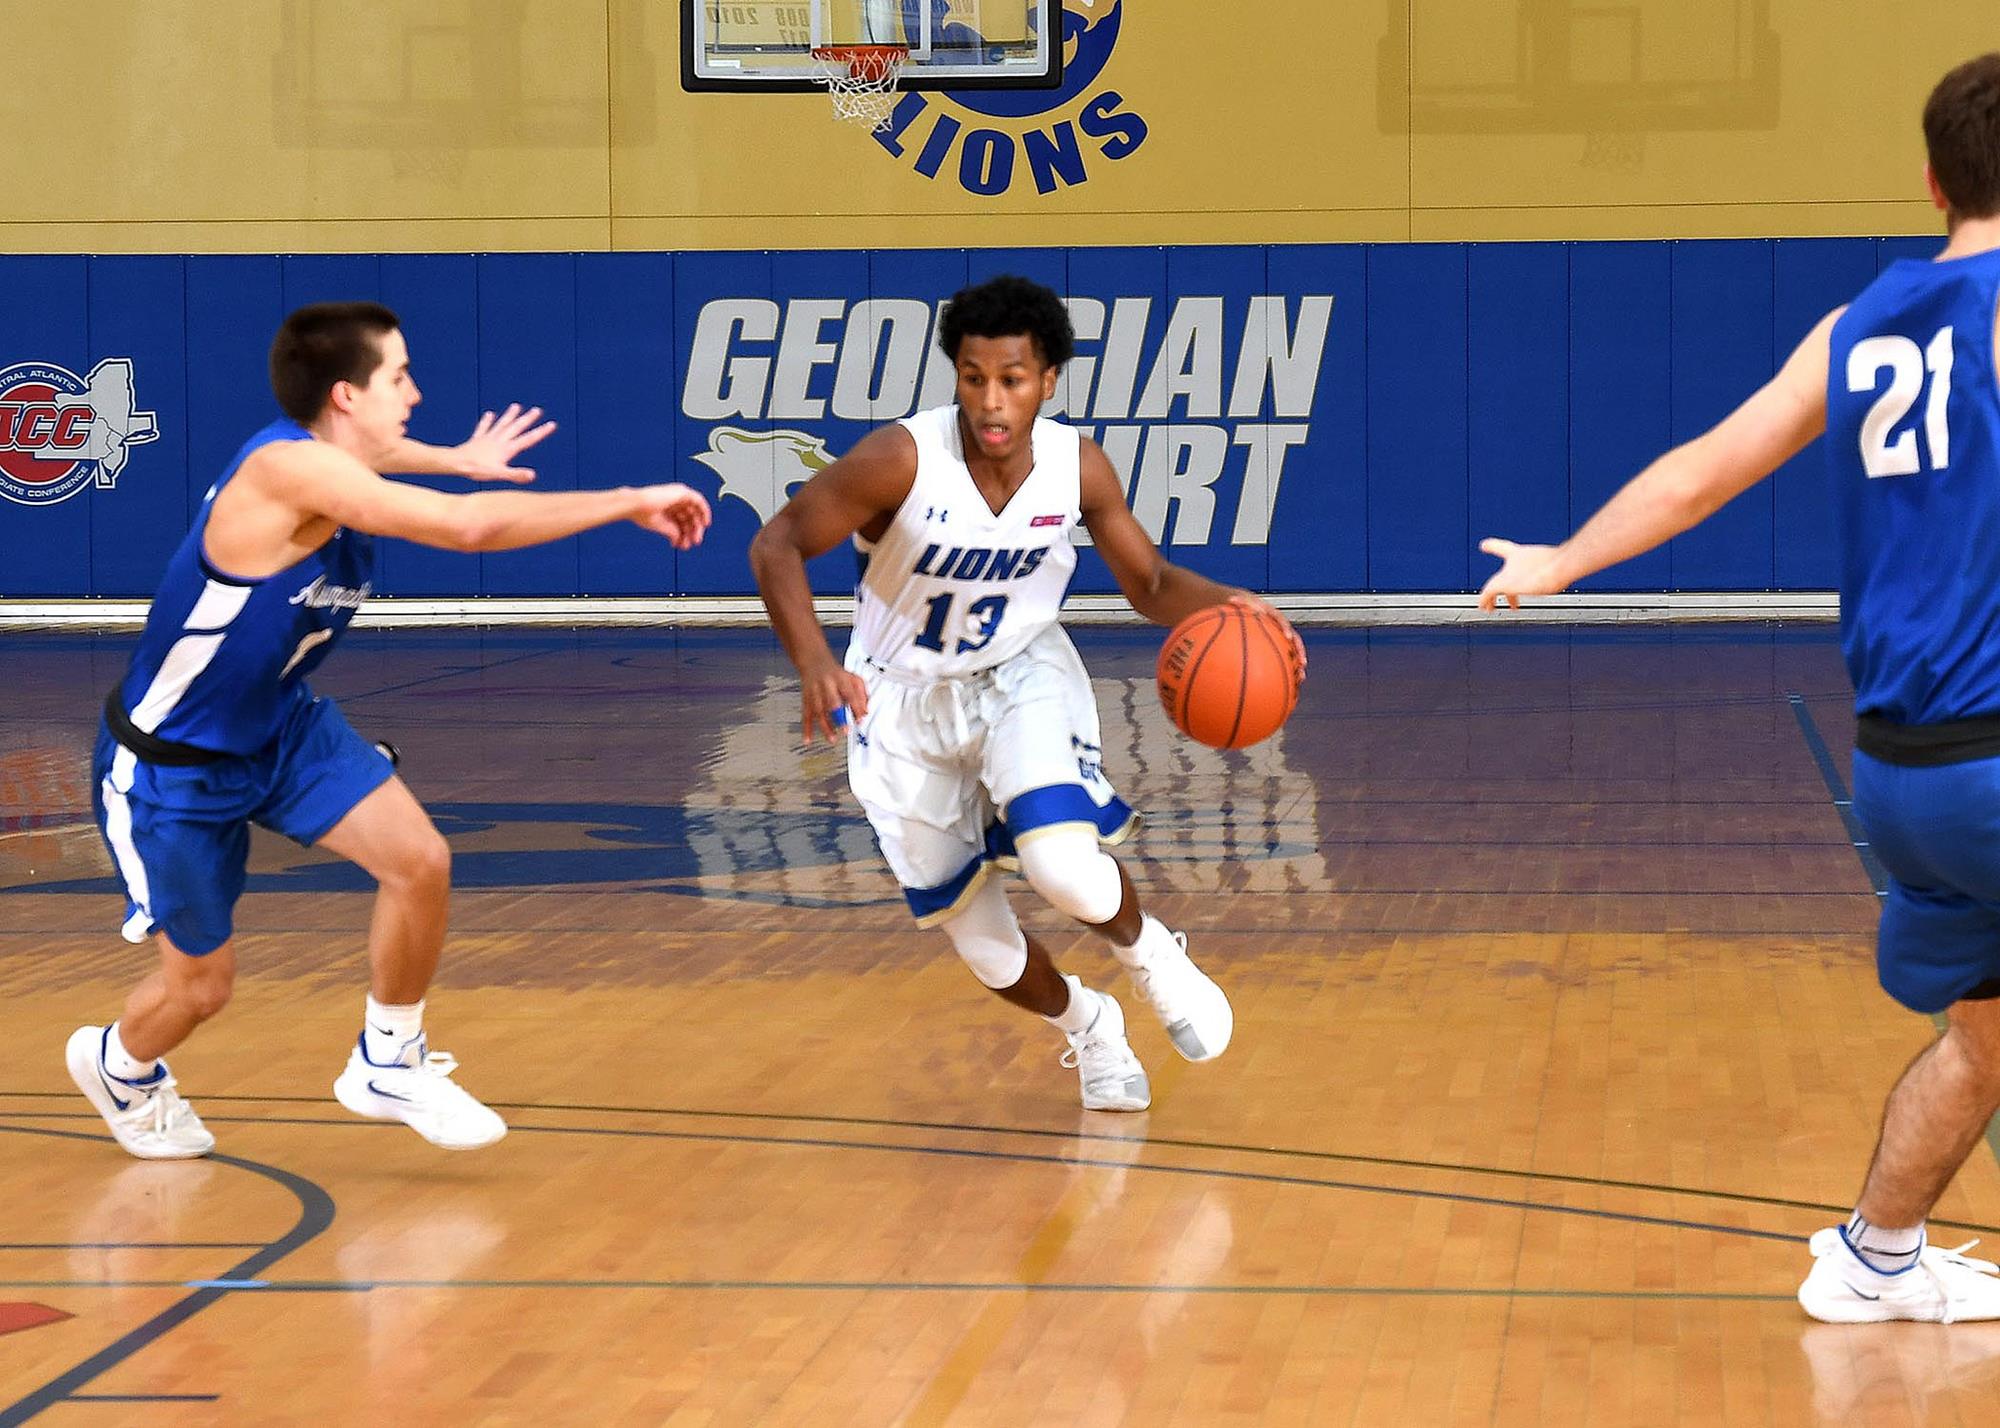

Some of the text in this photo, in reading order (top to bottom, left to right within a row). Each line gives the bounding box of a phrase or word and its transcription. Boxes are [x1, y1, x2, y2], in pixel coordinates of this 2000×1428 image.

[871, 91, 1148, 196] LIONS
[0, 370, 77, 392] TRAL ATLANTIC
[1846, 325, 1954, 479] 21
[27, 466, 89, 497] CONFERENCE
[913, 543, 1051, 582] LIONS
[913, 592, 1010, 654] 13
